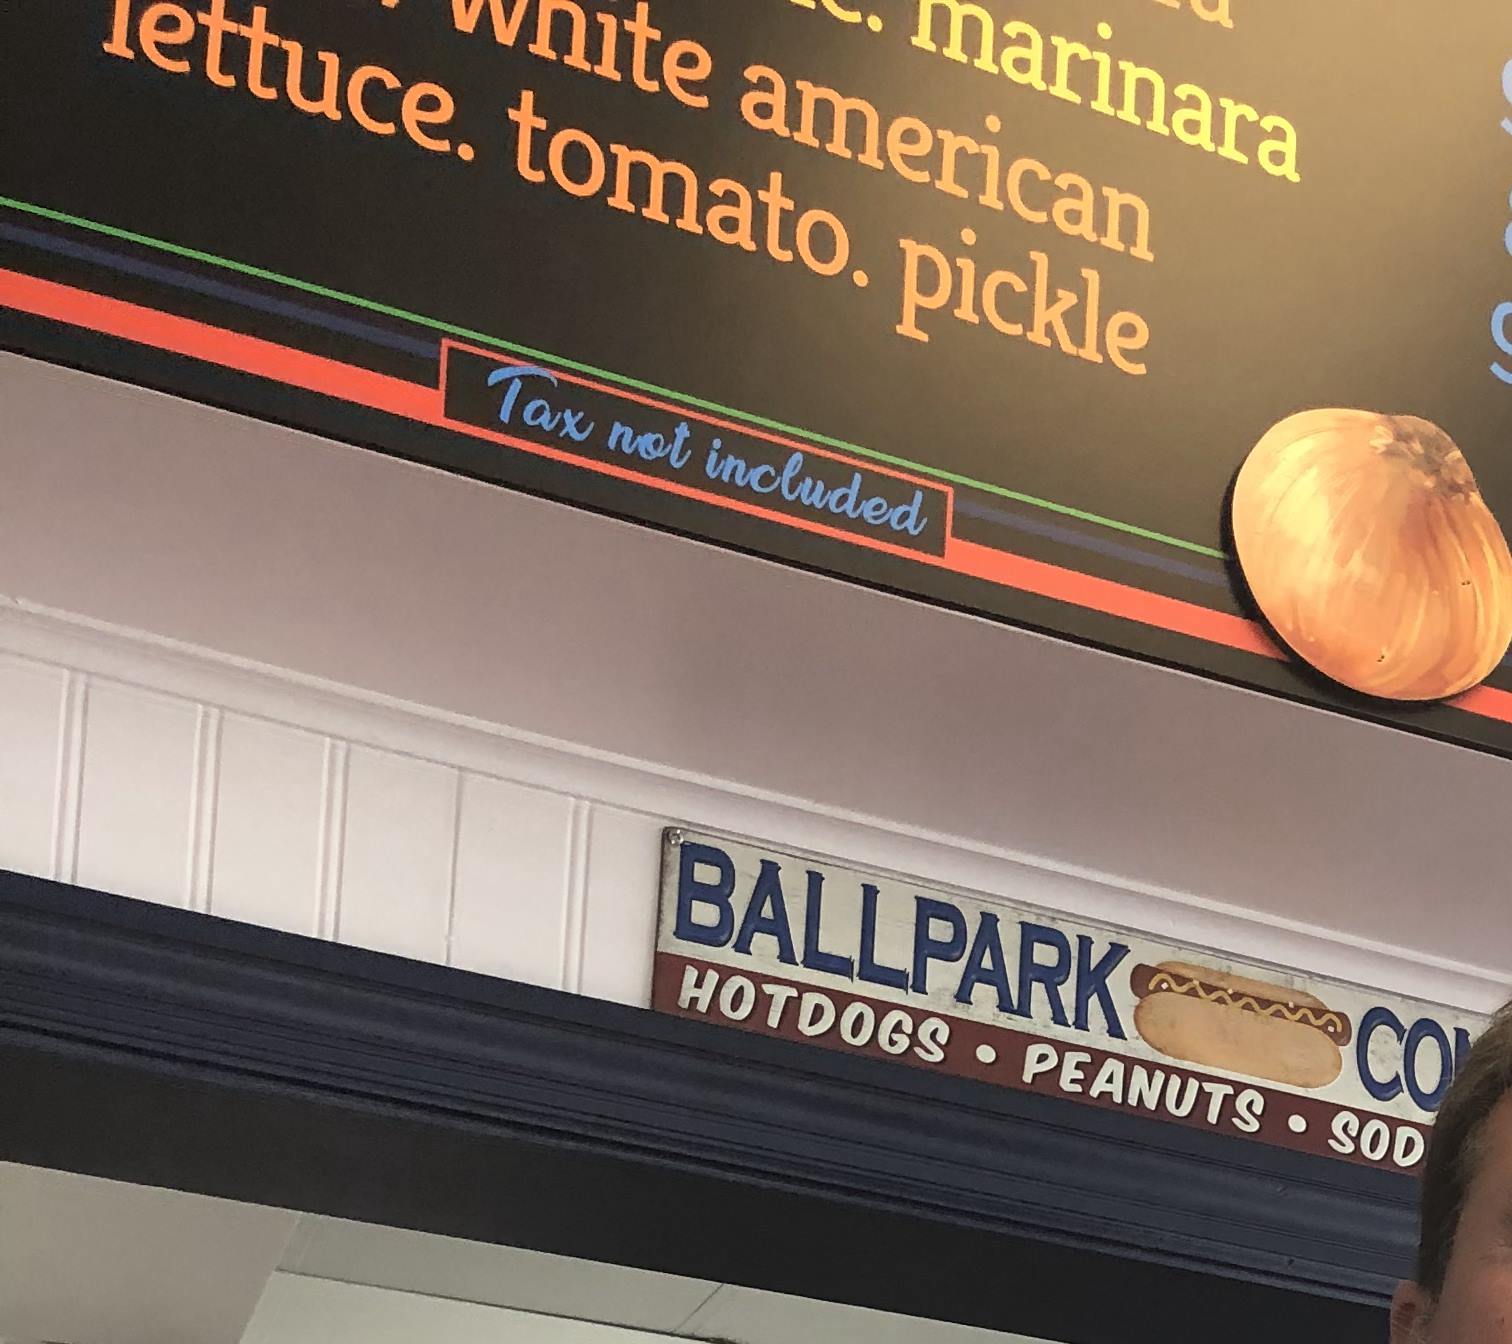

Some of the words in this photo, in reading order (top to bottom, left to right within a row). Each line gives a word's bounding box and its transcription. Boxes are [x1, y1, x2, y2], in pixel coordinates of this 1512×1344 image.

[740, 63, 1155, 262] american
[910, 0, 1301, 183] marinara
[102, 0, 475, 161] lettuce.
[508, 90, 870, 288] tomato.
[895, 228, 1150, 376] pickle
[486, 364, 595, 442] Tax
[607, 420, 692, 470] not
[704, 437, 929, 536] included
[672, 840, 1131, 1041] BALLPARK
[676, 965, 951, 1064] HOTDOGS
[1022, 1042, 1266, 1134] PEANUTS
